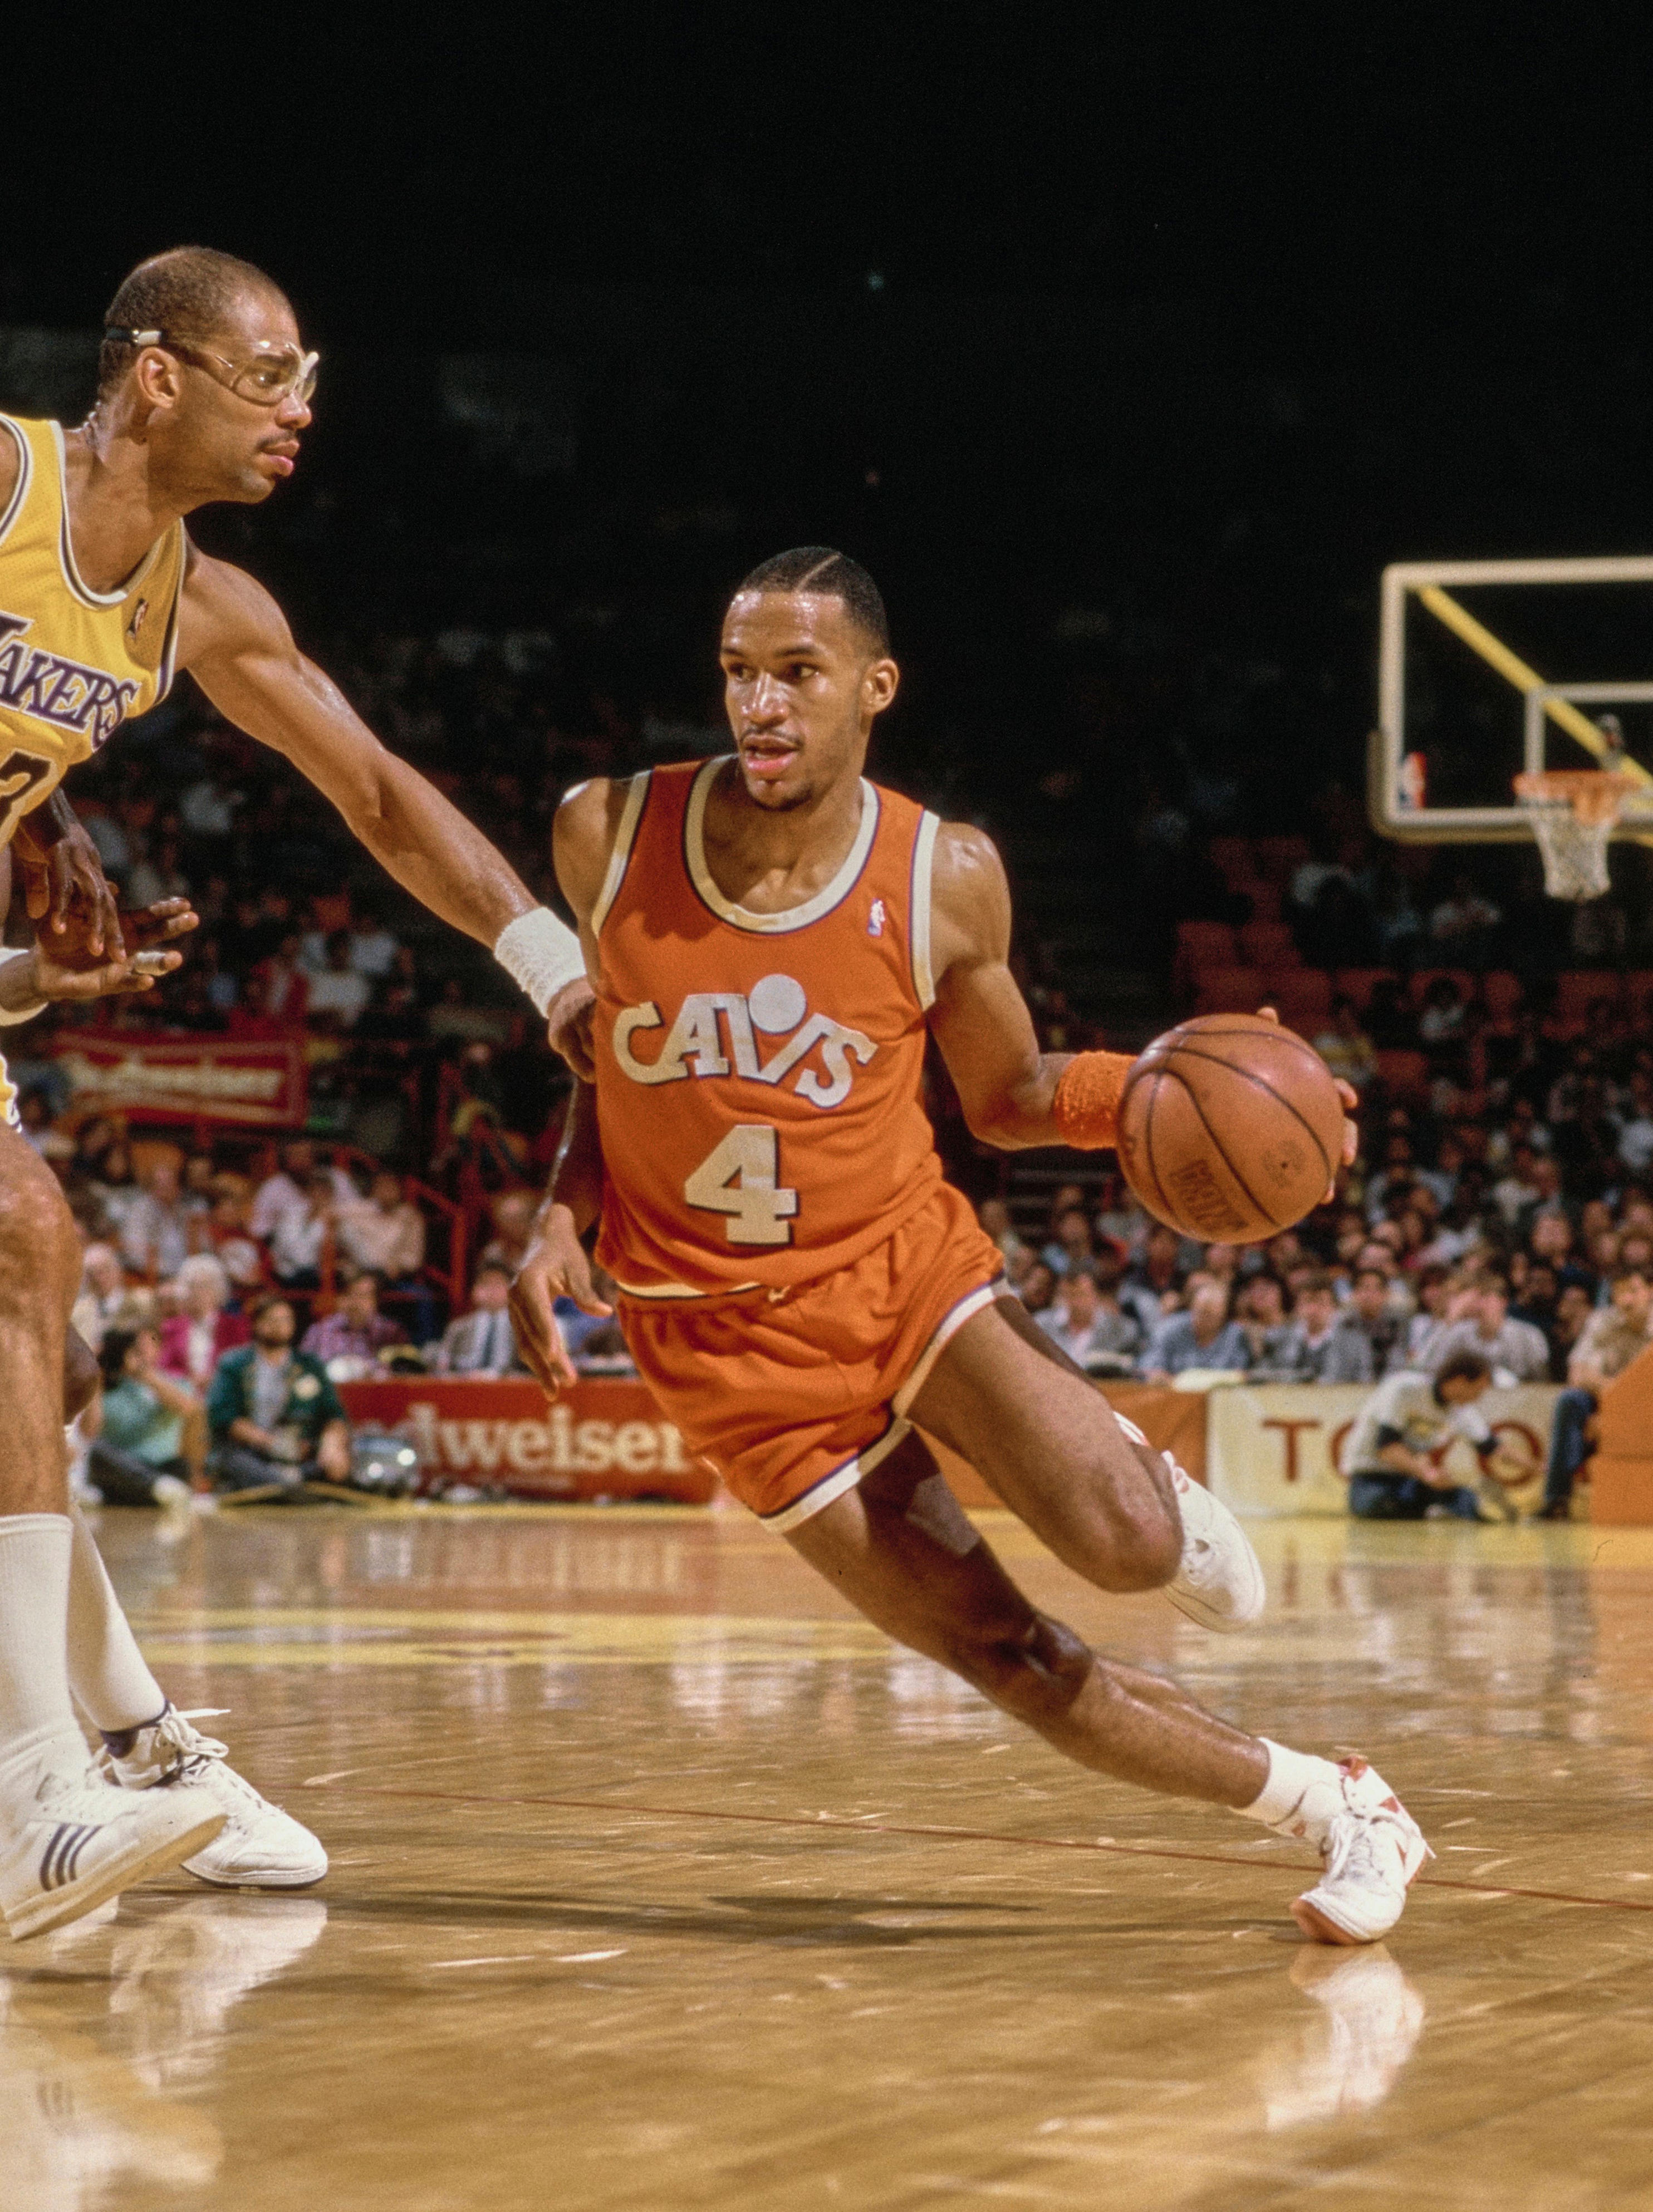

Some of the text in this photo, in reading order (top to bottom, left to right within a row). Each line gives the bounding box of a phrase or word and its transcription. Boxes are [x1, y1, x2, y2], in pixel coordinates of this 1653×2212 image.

[0, 609, 142, 753] AKERS
[613, 993, 879, 1108] CAVS
[684, 1124, 799, 1245] 4
